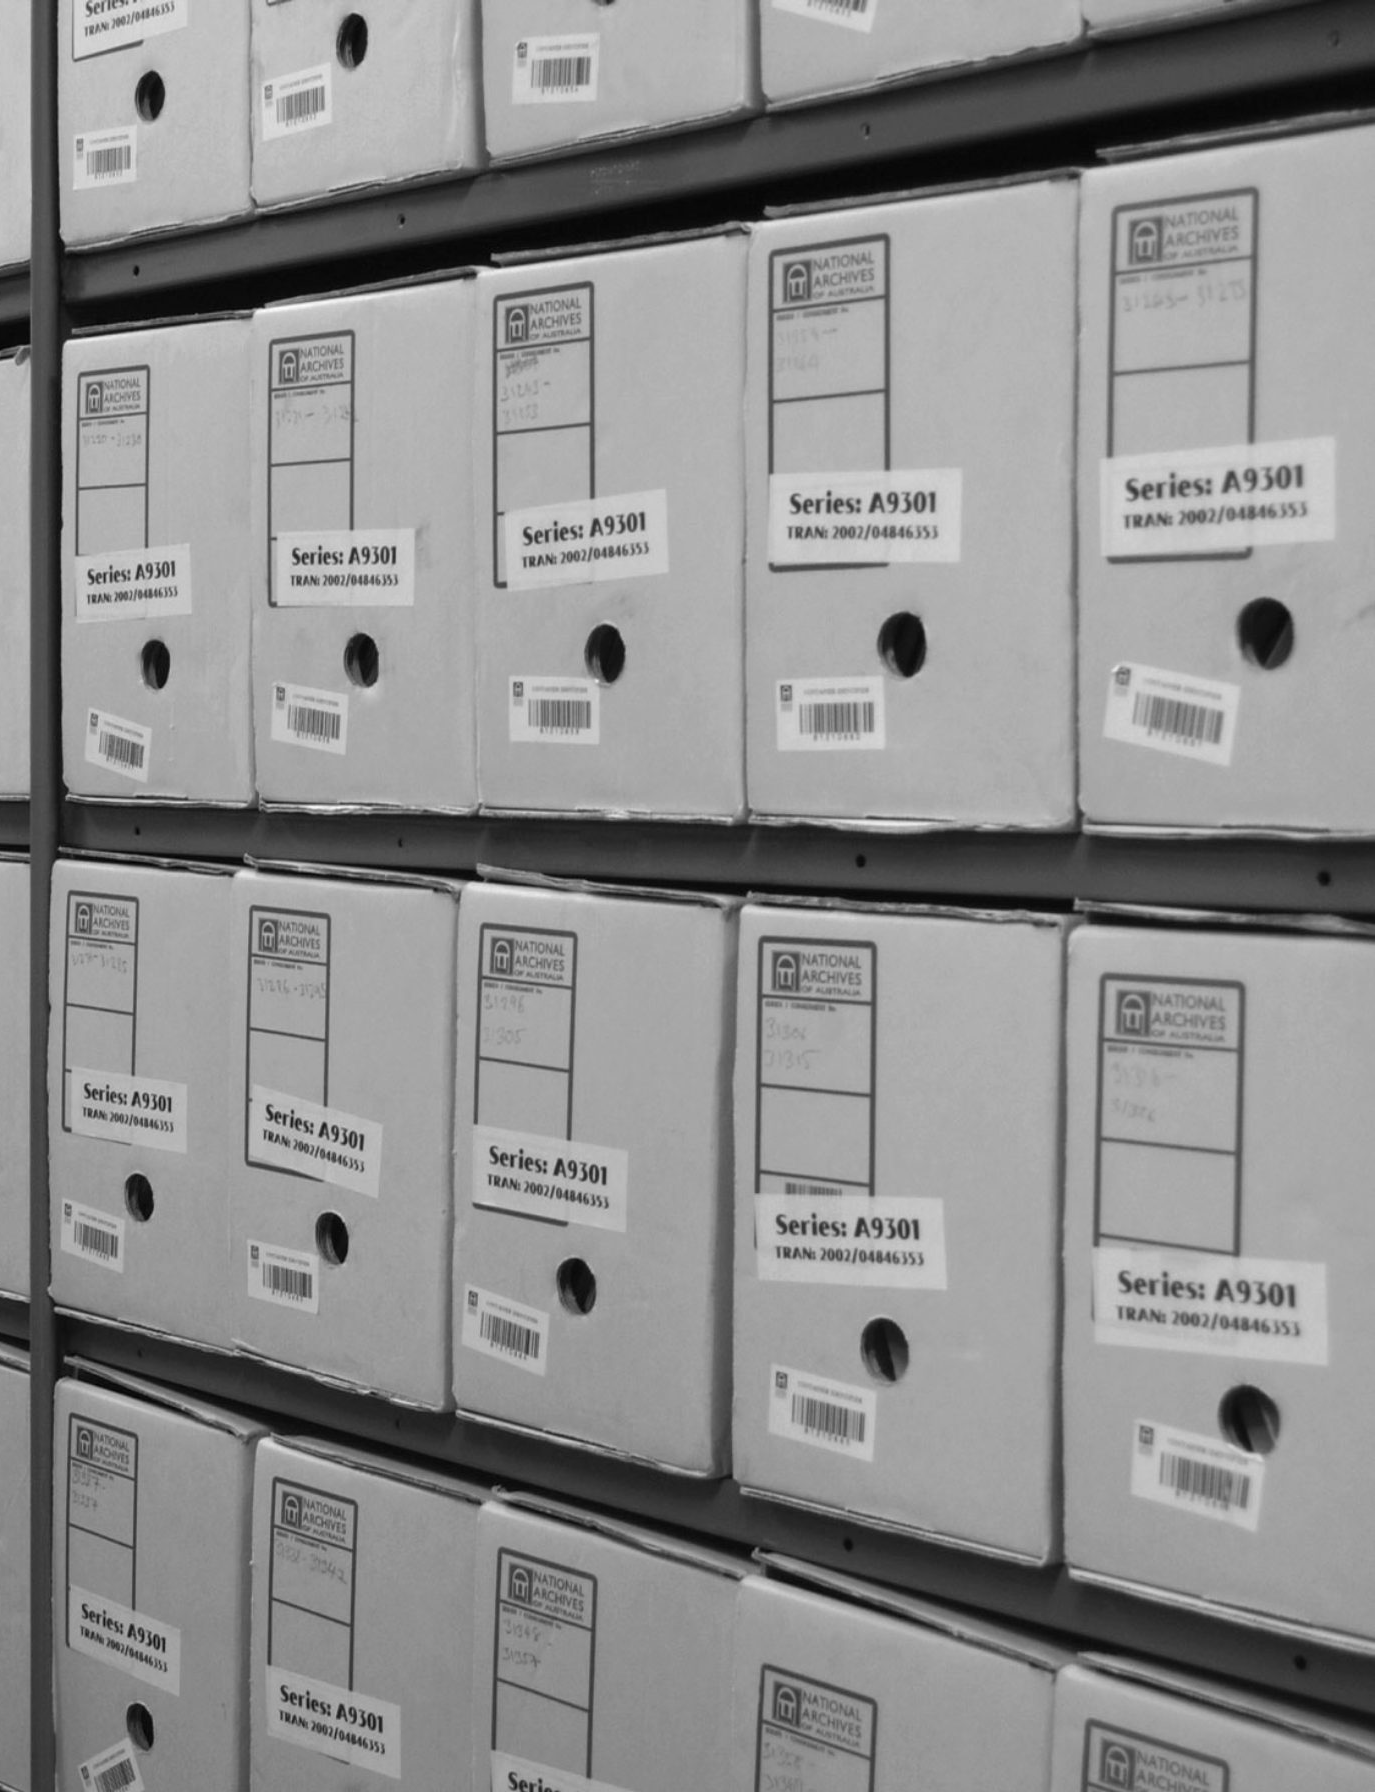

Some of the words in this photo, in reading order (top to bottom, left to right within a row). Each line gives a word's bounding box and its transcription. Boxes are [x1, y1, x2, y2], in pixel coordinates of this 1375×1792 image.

[84, 21, 110, 37] TRAN:
[111, 1, 175, 30] 2002/04846353
[1165, 207, 1239, 229] NATIONAL
[1164, 225, 1239, 249] ARCHIVES
[812, 251, 875, 271] NATIONAL
[813, 267, 875, 289] ARCHIVES
[530, 297, 582, 315] NATIONAL
[530, 312, 582, 331] ARCHIVES
[300, 343, 345, 359] NATIONAL
[299, 357, 344, 374] ARCHIVES
[103, 377, 141, 393] NATIONAL
[103, 390, 141, 404] ARCHIVES
[1125, 472, 1213, 502] Series:
[1221, 464, 1304, 494] A9301
[789, 490, 862, 515] Series:
[868, 491, 936, 514] A9301
[1124, 512, 1173, 529] TRAN:
[1179, 502, 1307, 525] 2002/04846353
[522, 520, 584, 546] Series:
[589, 511, 646, 538] A9301
[788, 526, 828, 539] TRAN:
[832, 525, 938, 540] 2002/04846353
[291, 545, 344, 566] Series:
[348, 546, 397, 565] A9301
[522, 554, 557, 568] TRAN:
[560, 542, 649, 564] 2002/04846353
[87, 564, 131, 586] Series:
[134, 560, 176, 581] A9301
[290, 575, 320, 586] TRAN:
[323, 573, 399, 587] 2002/04846353
[87, 593, 112, 604] TRAN:
[114, 586, 178, 602] 2002/04846353
[94, 904, 130, 919] NATIONAL
[93, 917, 130, 931] ARCHIVES
[278, 921, 321, 937] NATIONAL
[278, 934, 321, 950] ARCHIVES
[514, 940, 566, 957] NATIONAL
[514, 955, 565, 972] ARCHIVES
[801, 953, 862, 970] NATIONAL
[801, 969, 862, 986] ARCHIVES
[1151, 993, 1226, 1013] NATIONAL
[1151, 1011, 1226, 1032] ARCHIVES
[83, 1082, 128, 1106] Series:
[131, 1091, 172, 1113] A9301
[83, 1107, 107, 1120] TRAN:
[109, 1112, 174, 1132] 2002/04846353
[265, 1103, 315, 1135] Series:
[318, 1121, 365, 1152] A9301
[263, 1129, 291, 1148] TRAN:
[293, 1139, 365, 1173] 2002/04846353
[489, 1145, 548, 1175] Series:
[553, 1157, 607, 1186] A9301
[488, 1174, 521, 1191] TRAN:
[524, 1181, 610, 1209] 2002/04846353
[775, 1212, 847, 1238] Series:
[853, 1217, 920, 1241] A9301
[776, 1246, 816, 1260] TRAN:
[820, 1248, 924, 1266] 2002/04846353
[1118, 1270, 1206, 1300] Series:
[1214, 1278, 1297, 1309] A9301
[1118, 1306, 1166, 1324] TRAN:
[1172, 1311, 1301, 1337] 2002/04846353
[94, 1432, 130, 1453] NATIONAL
[94, 1444, 130, 1465] ARCHIVES
[303, 1498, 347, 1522] NATIONAL
[302, 1511, 347, 1535] ARCHIVES
[533, 1571, 585, 1598] NATIONAL
[531, 1583, 584, 1613] ARCHIVES
[81, 1603, 124, 1635] Series:
[126, 1623, 166, 1654] A9301
[80, 1626, 104, 1645] TRAN:
[106, 1637, 168, 1673] 2002/04846353
[280, 1684, 331, 1717] Series:
[335, 1703, 383, 1734] A9301
[803, 1691, 862, 1723] NATIONAL
[279, 1710, 308, 1729] TRAN:
[311, 1721, 386, 1755] 2002/04846353
[802, 1707, 862, 1739] ARCHIVES
[1136, 1751, 1210, 1787] NATIONAL
